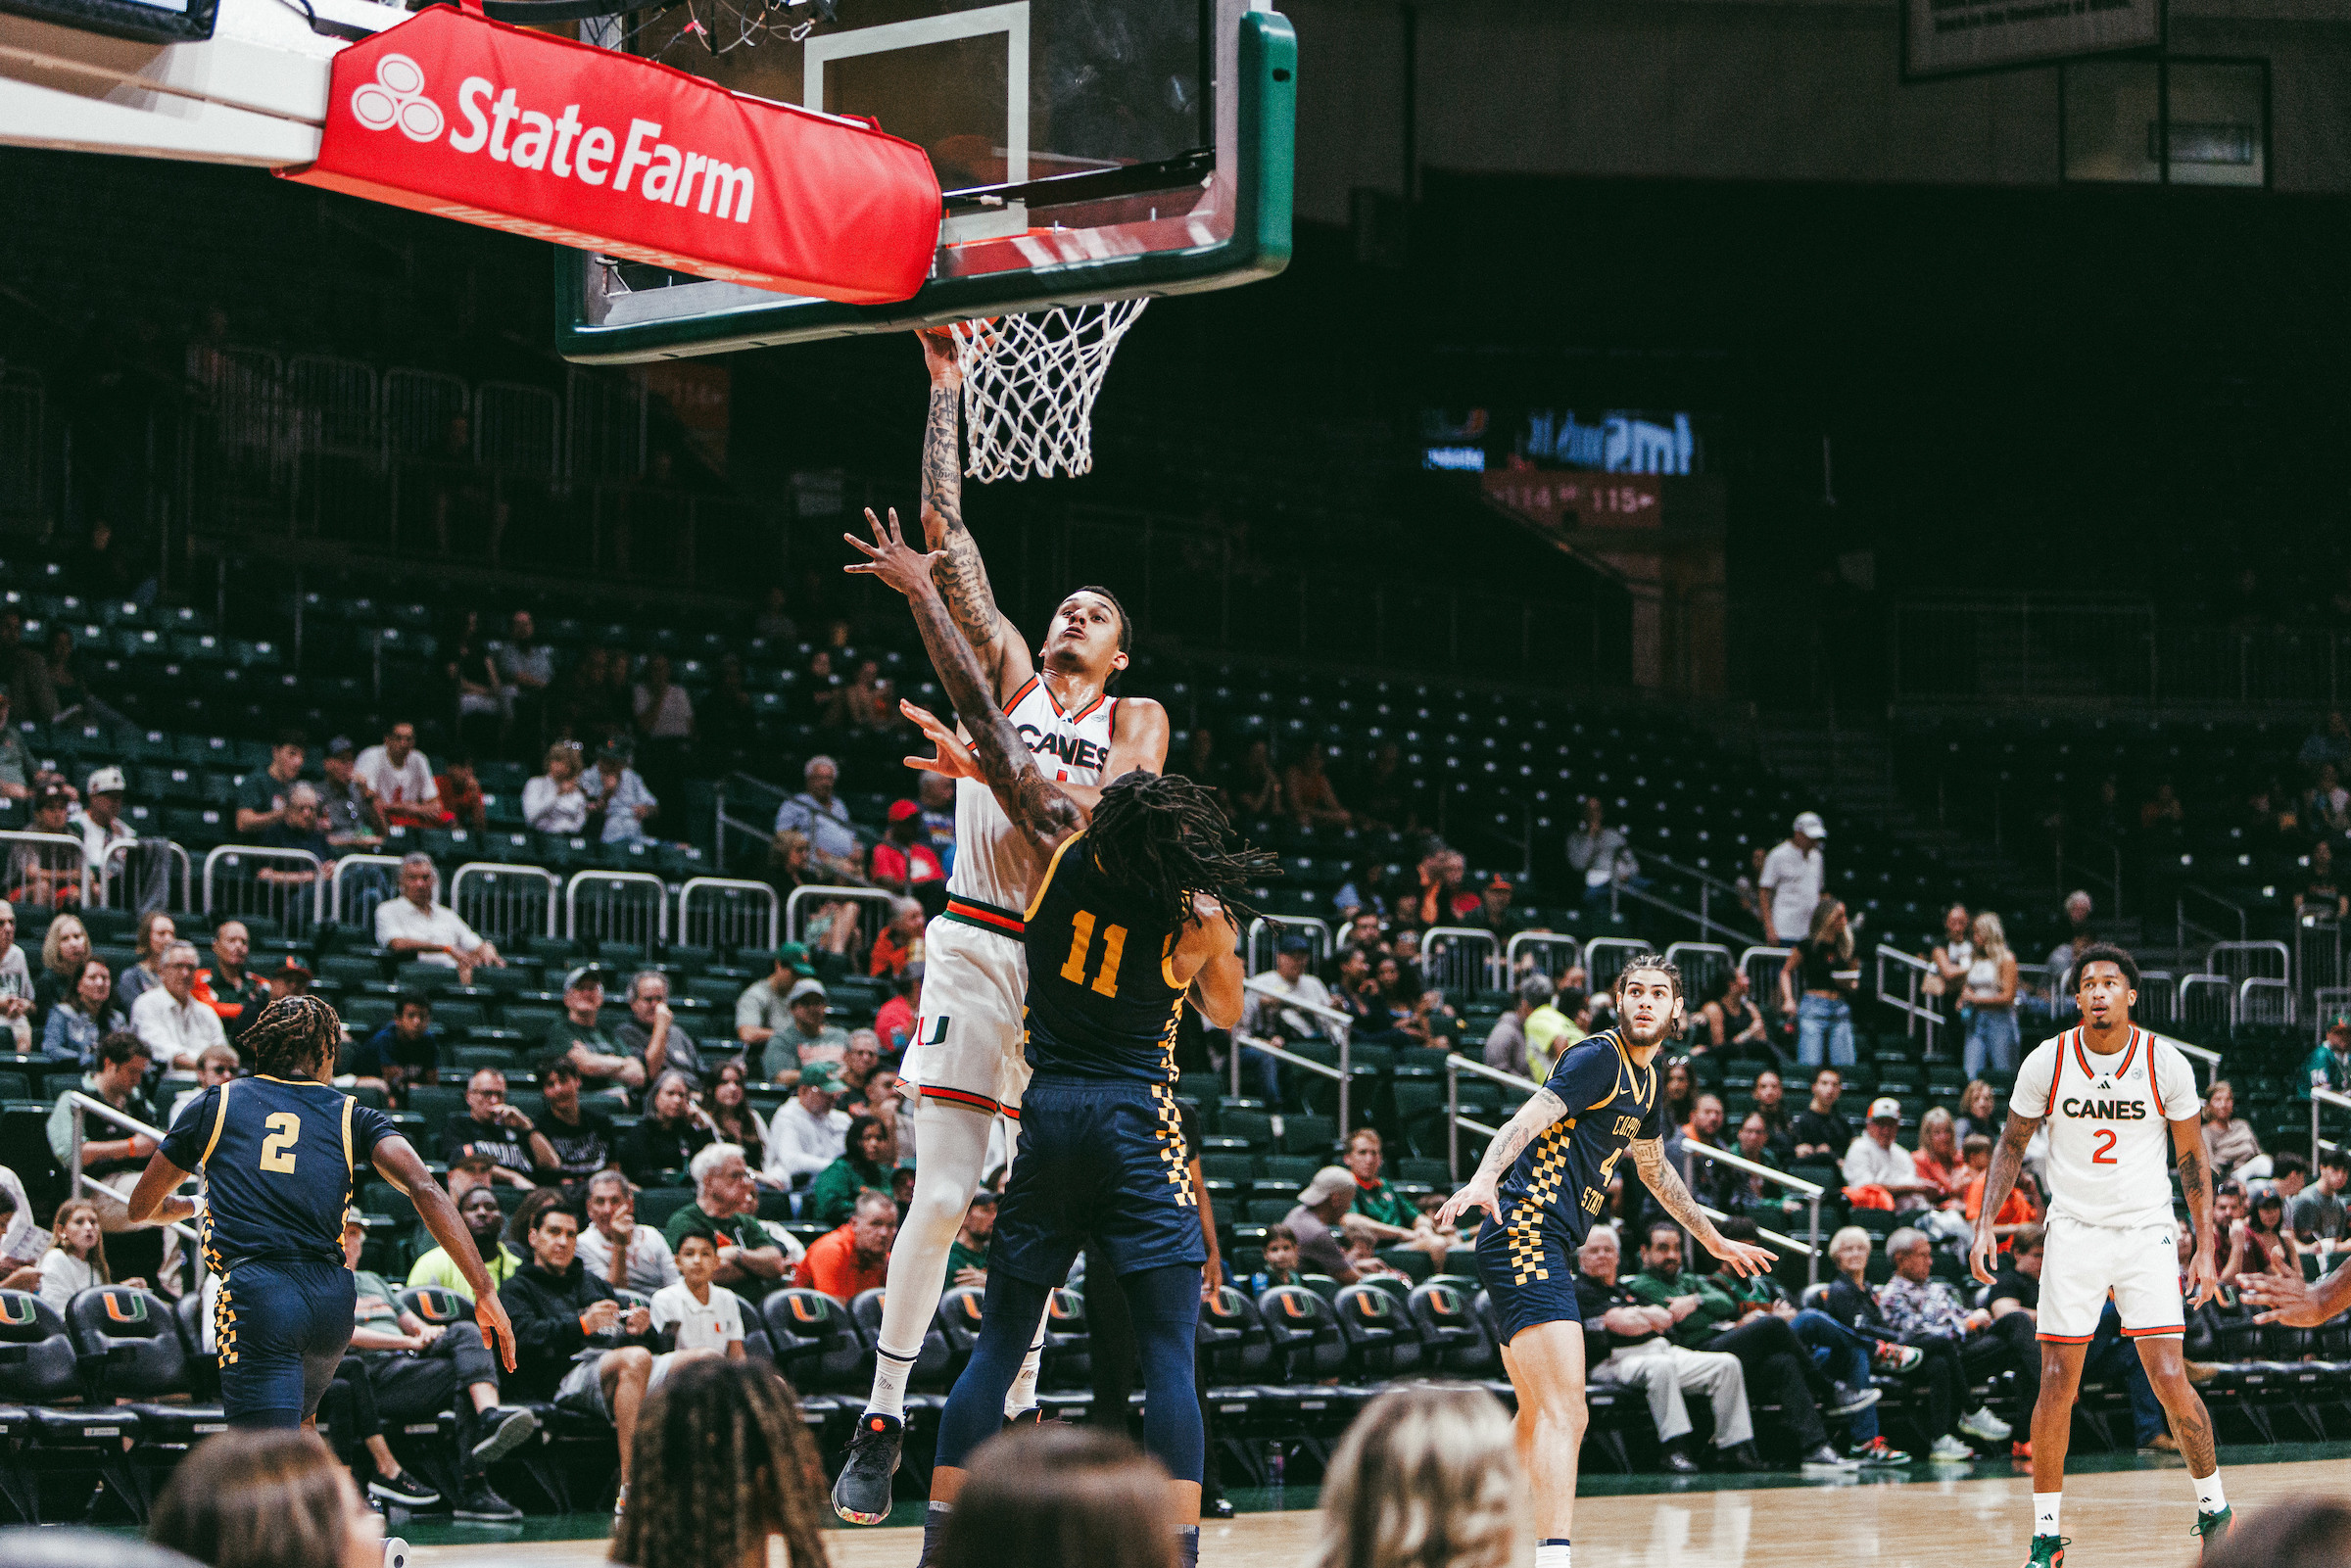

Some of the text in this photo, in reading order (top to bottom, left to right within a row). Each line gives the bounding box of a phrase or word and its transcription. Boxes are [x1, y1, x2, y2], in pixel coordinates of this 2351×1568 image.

[1059, 909, 1128, 998] 11
[917, 1016, 950, 1046] U
[2062, 1097, 2147, 1120] CANES
[259, 1111, 302, 1175] 2
[2091, 1127, 2118, 1164] 2
[1599, 1147, 1624, 1188] 4
[103, 1291, 148, 1324] U
[417, 1290, 460, 1321] U
[789, 1294, 830, 1323] U
[1280, 1291, 1316, 1318] U
[1356, 1291, 1388, 1317] U
